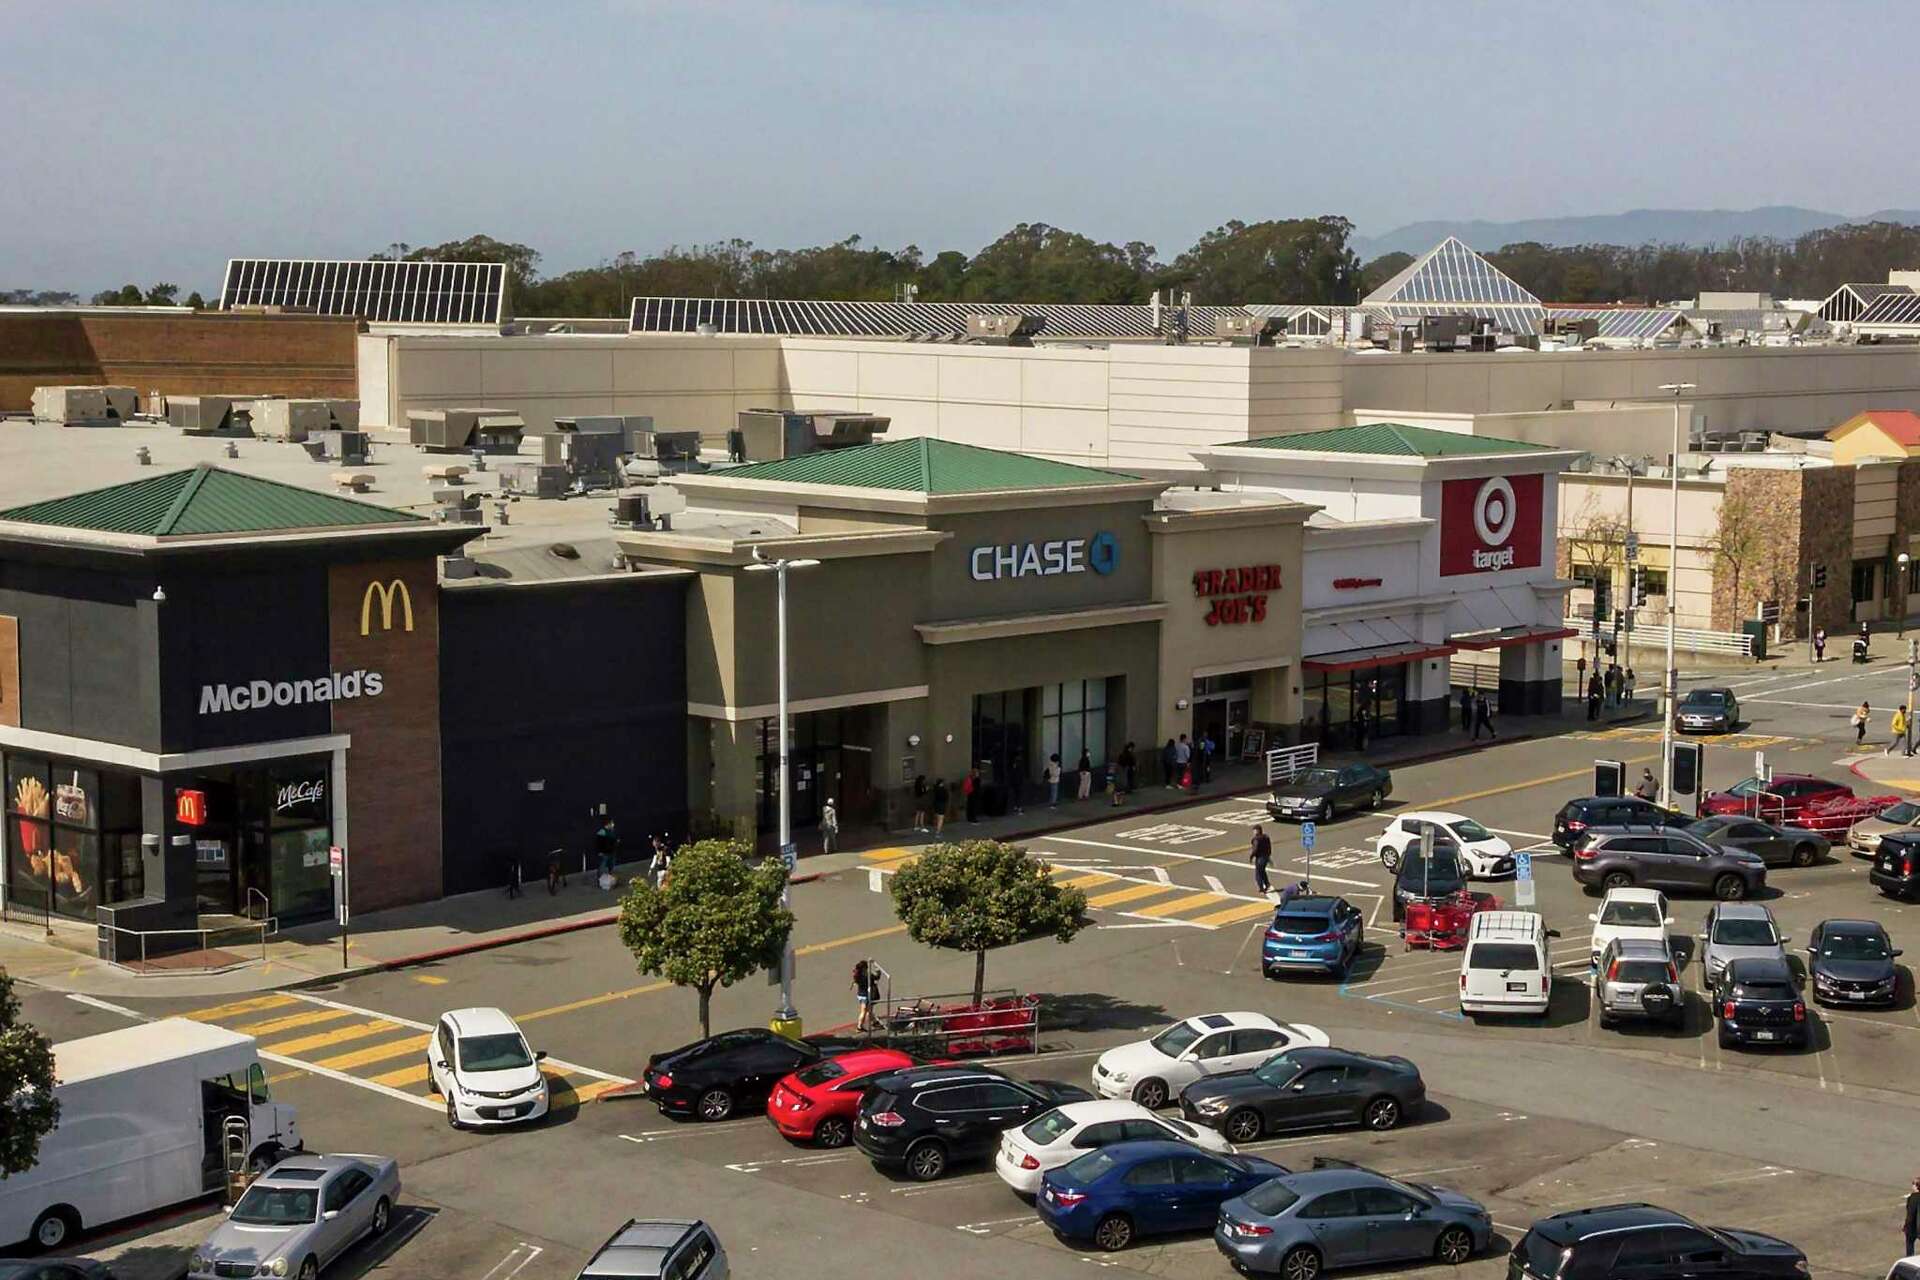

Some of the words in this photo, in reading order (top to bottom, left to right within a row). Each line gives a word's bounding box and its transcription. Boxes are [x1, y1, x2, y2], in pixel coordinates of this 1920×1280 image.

[971, 539, 1087, 581] CHASE
[1472, 546, 1515, 572] target
[1193, 564, 1282, 597] TRADER
[199, 669, 384, 714] McDonald's
[277, 780, 324, 810] McCafé
